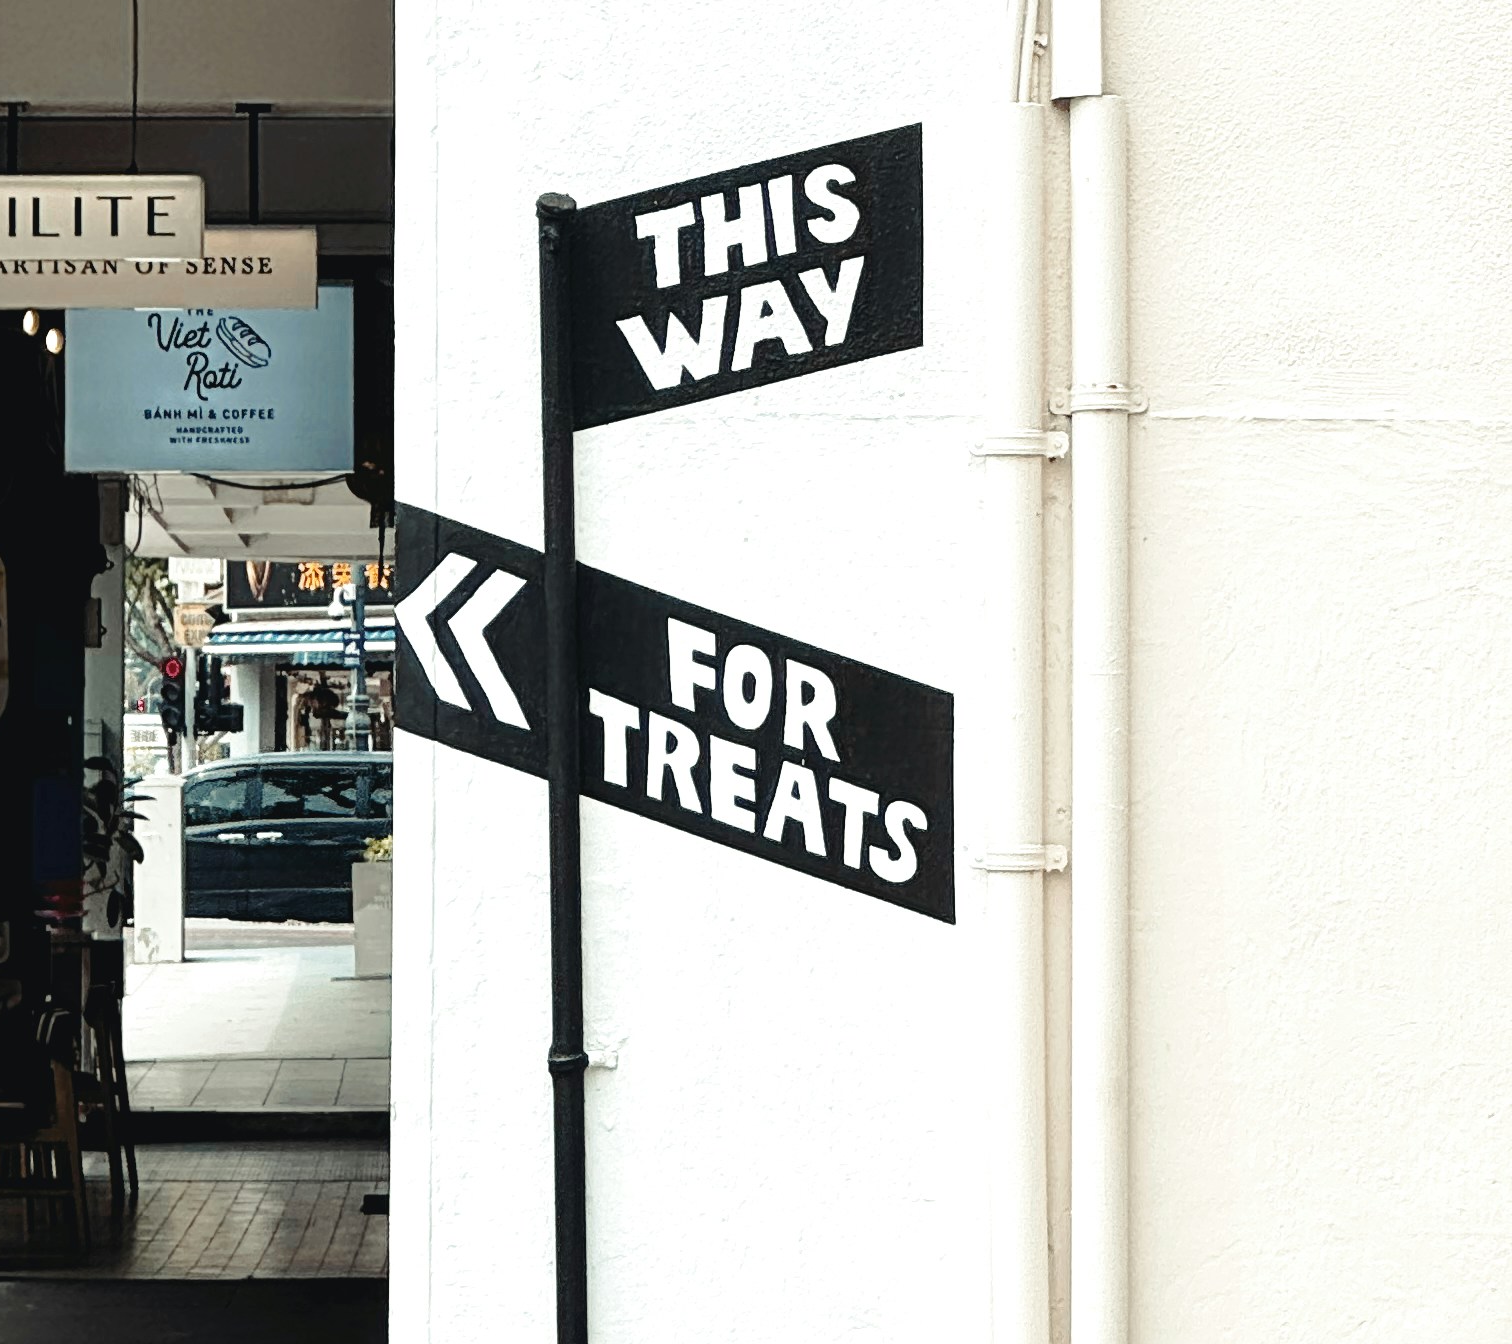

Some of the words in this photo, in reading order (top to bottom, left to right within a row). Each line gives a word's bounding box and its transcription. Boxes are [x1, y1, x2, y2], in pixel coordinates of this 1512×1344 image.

[635, 162, 862, 290] THIS
[135, 260, 170, 275] OF
[185, 257, 273, 275] SENSE
[148, 312, 212, 352] Viet
[614, 255, 866, 392] WAY
[184, 351, 243, 401] Roti
[144, 406, 182, 420] BÁNH
[208, 409, 217, 420] &
[222, 408, 275, 420] COFFEE
[169, 436, 193, 444] WITH
[666, 616, 842, 762] FOR
[587, 687, 930, 884] TREATS
